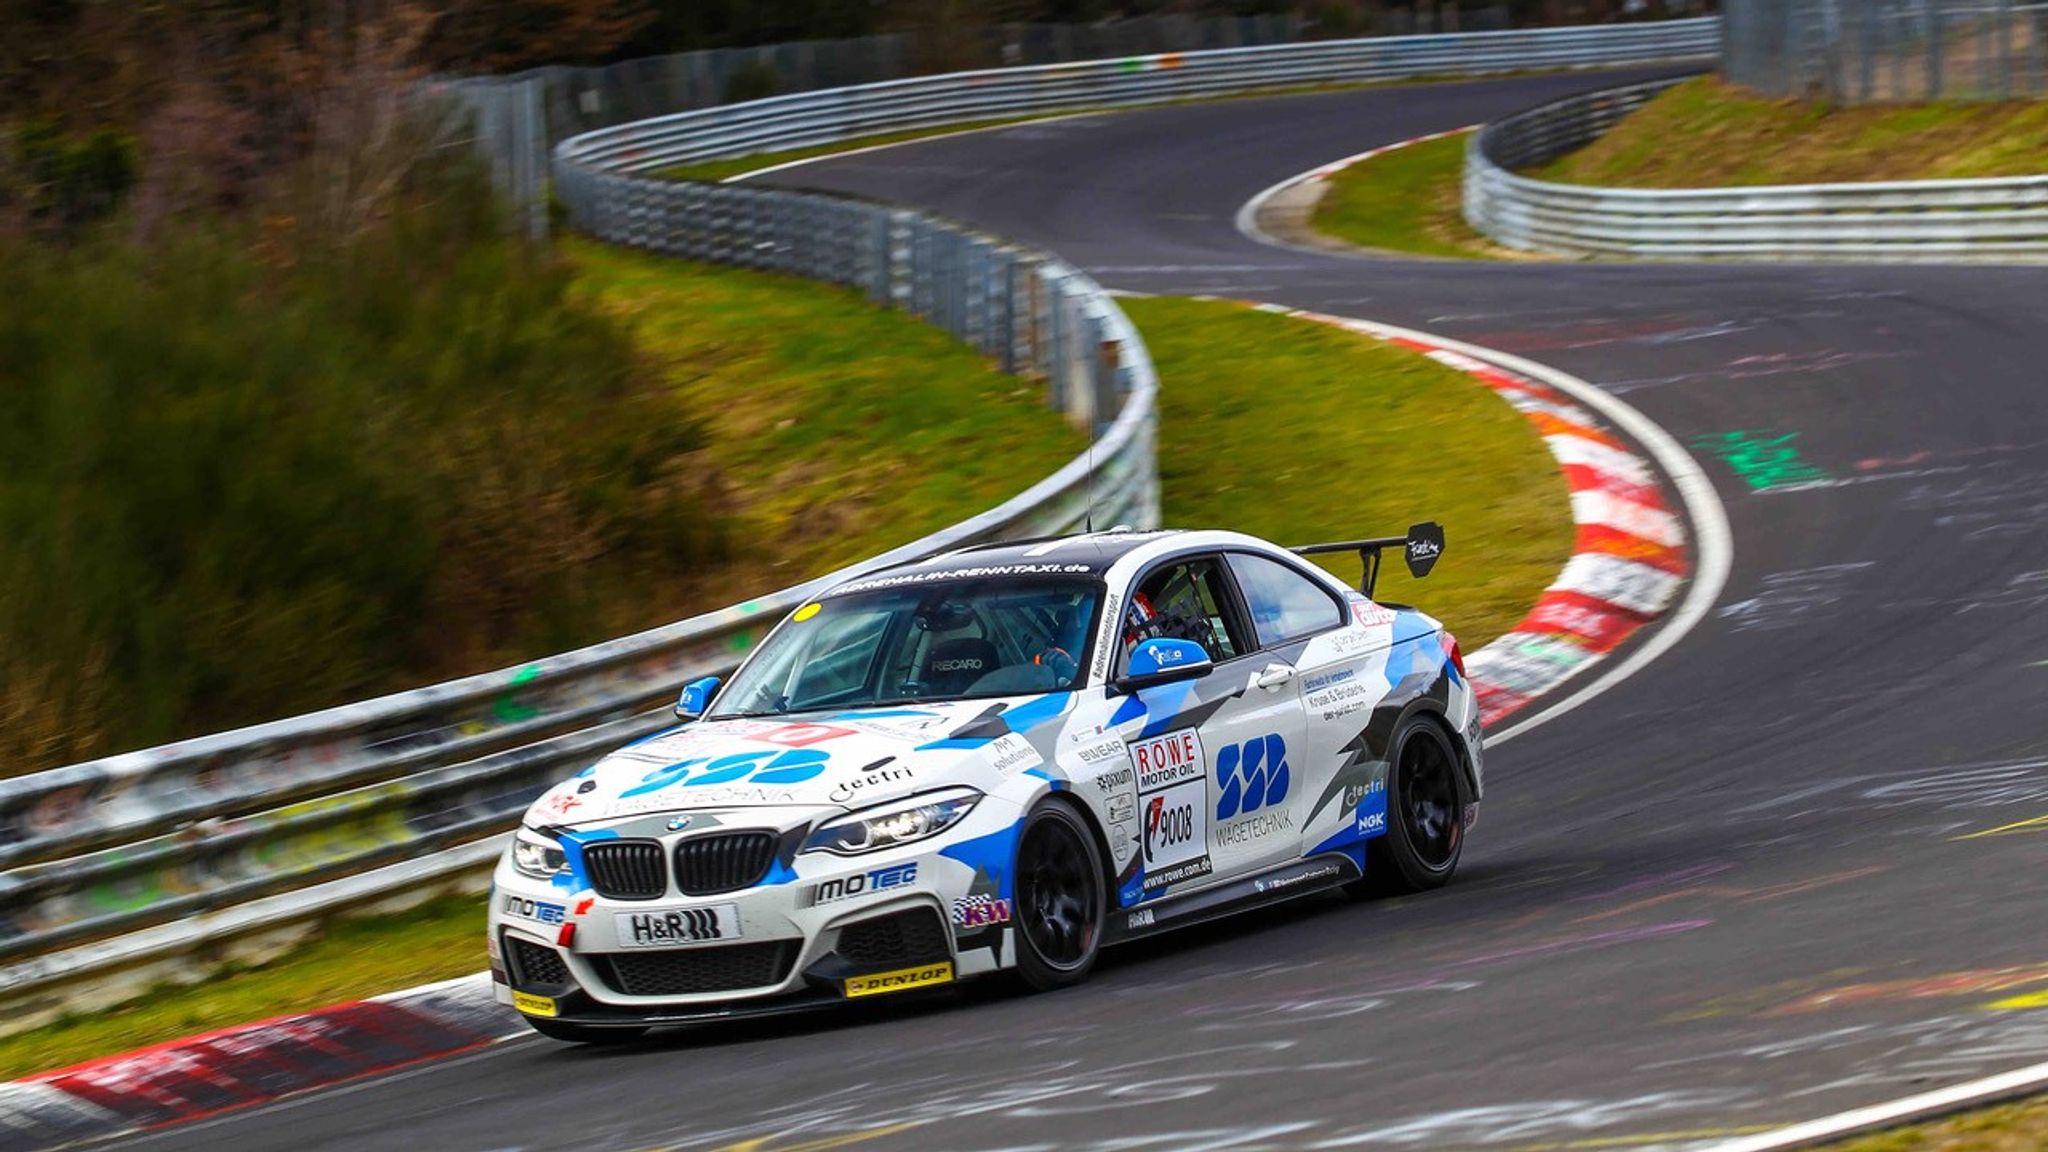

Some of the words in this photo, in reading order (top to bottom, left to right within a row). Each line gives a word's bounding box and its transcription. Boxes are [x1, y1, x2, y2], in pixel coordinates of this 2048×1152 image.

[931, 658, 983, 672] RECARO
[1137, 735, 1196, 775] ROWE
[617, 749, 834, 799] SSB
[1141, 769, 1178, 787] MOTOR
[1179, 764, 1196, 776] OIL
[1216, 733, 1290, 821] SSB
[1160, 803, 1192, 848] 9008
[1216, 809, 1294, 848] WÄGETECHNIK
[1358, 812, 1384, 832] NGK
[1142, 857, 1212, 889] www.rowe.com.de
[961, 899, 1011, 928] KW
[866, 967, 948, 990] DUNLOP
